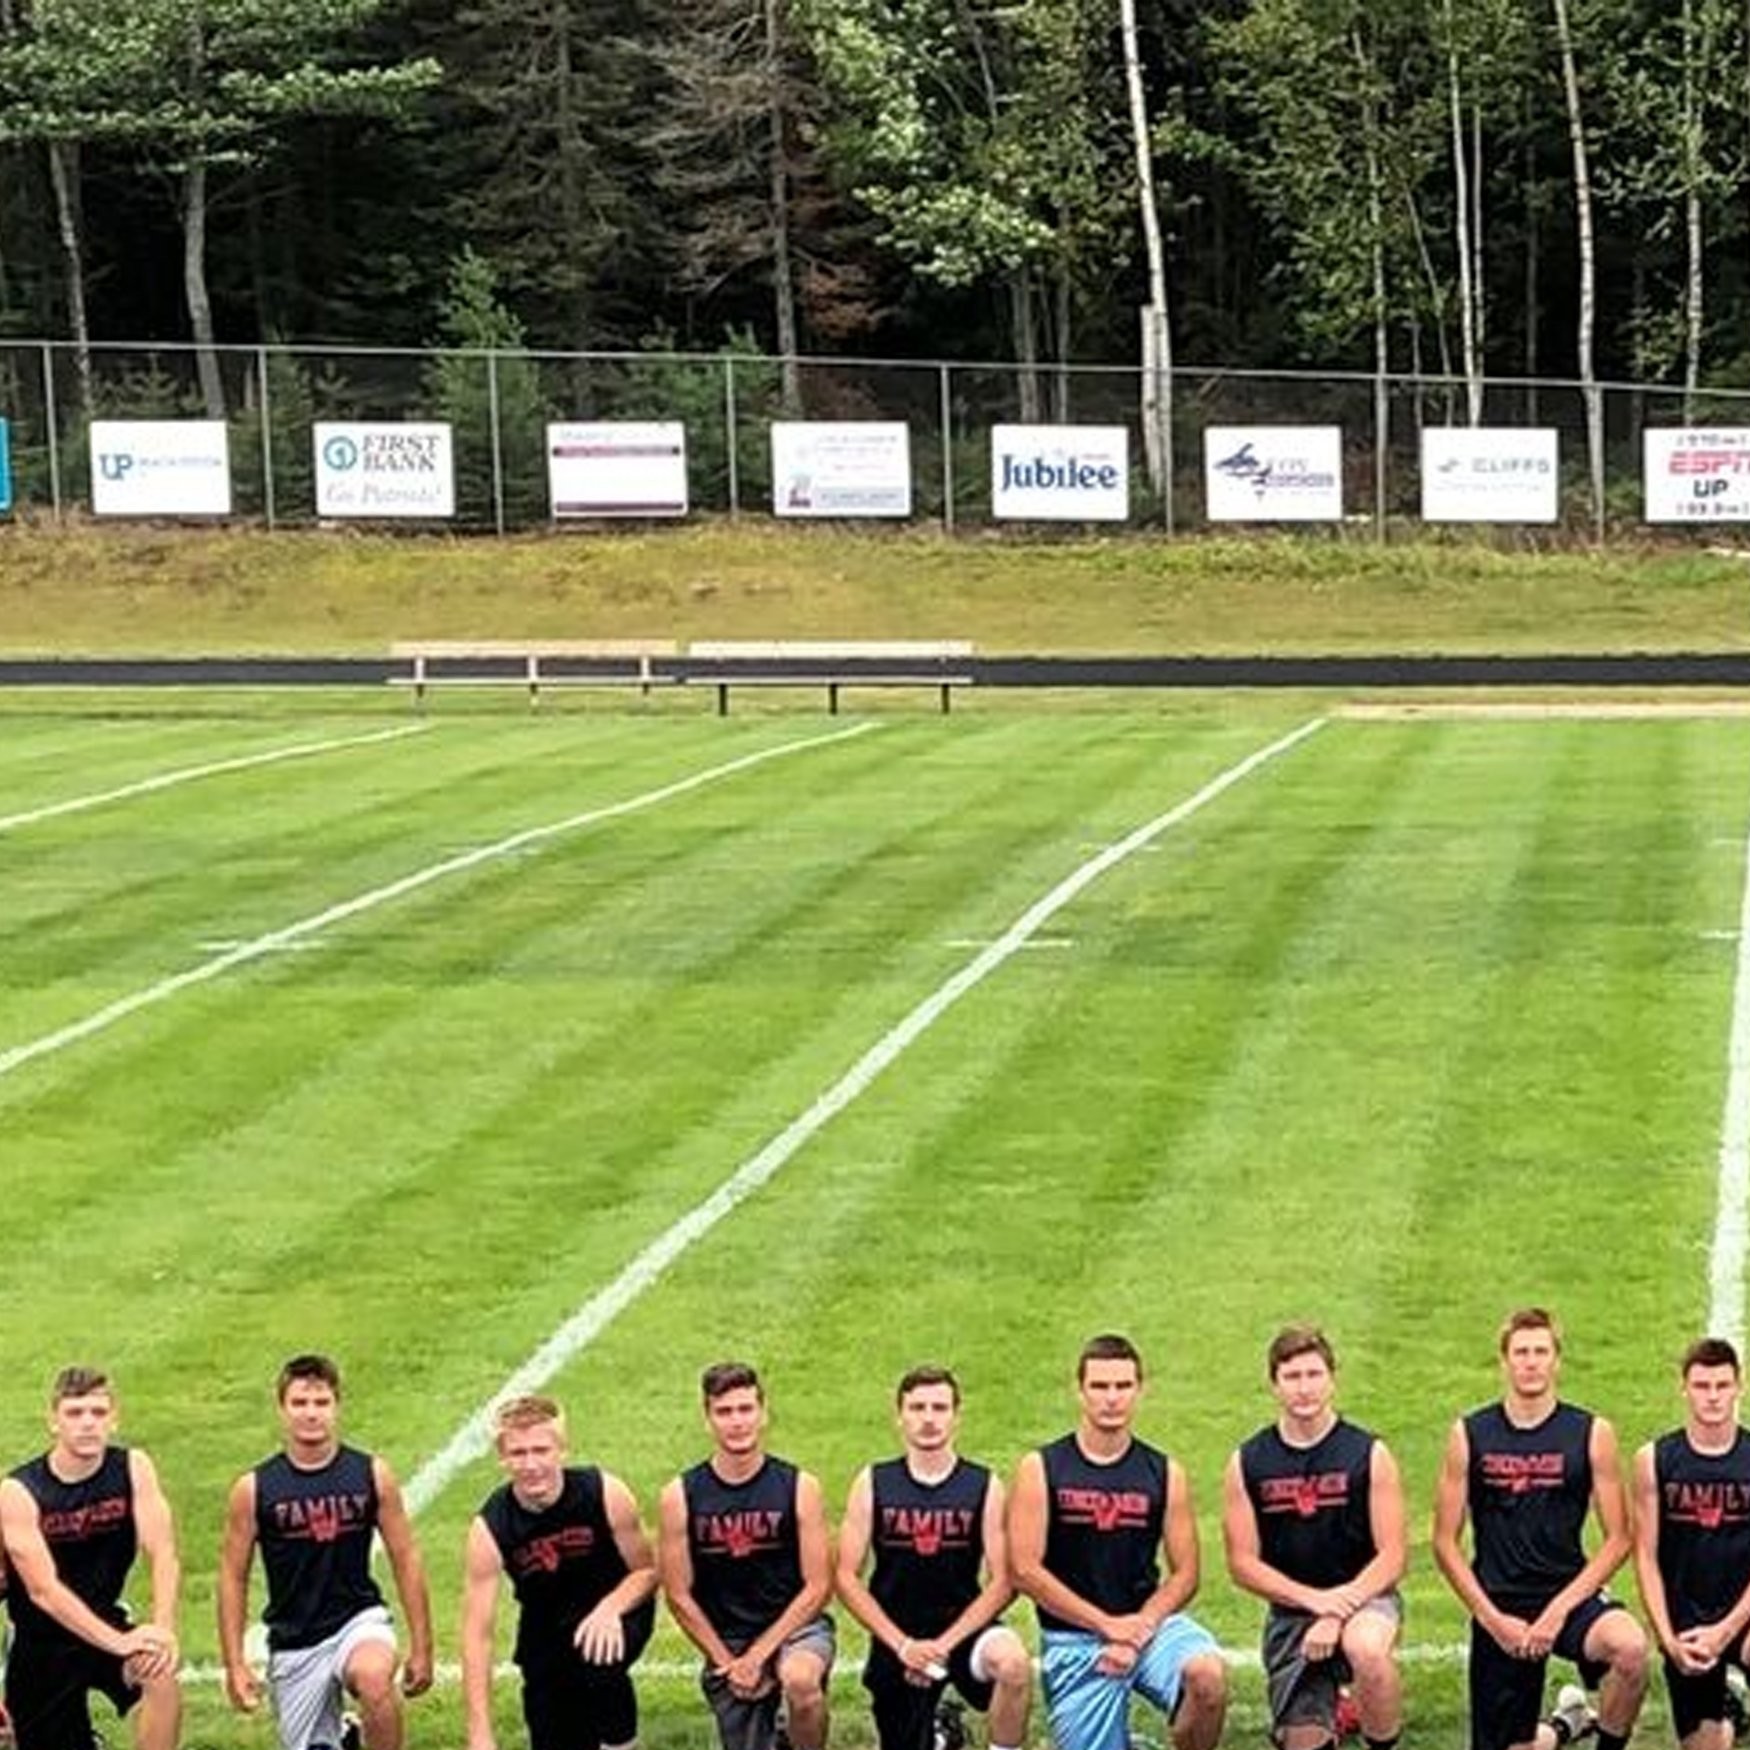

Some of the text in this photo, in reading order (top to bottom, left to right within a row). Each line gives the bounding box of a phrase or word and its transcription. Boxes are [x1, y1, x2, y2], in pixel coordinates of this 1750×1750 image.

[362, 434, 441, 453] FIRST
[98, 452, 133, 481] UP
[363, 452, 436, 472] BANK
[1001, 453, 1118, 491] Jubilee
[1693, 479, 1728, 498] UP
[275, 1494, 368, 1528] FAMILY
[883, 1507, 974, 1536] FAMILY
[695, 1510, 782, 1542] FAMILY
